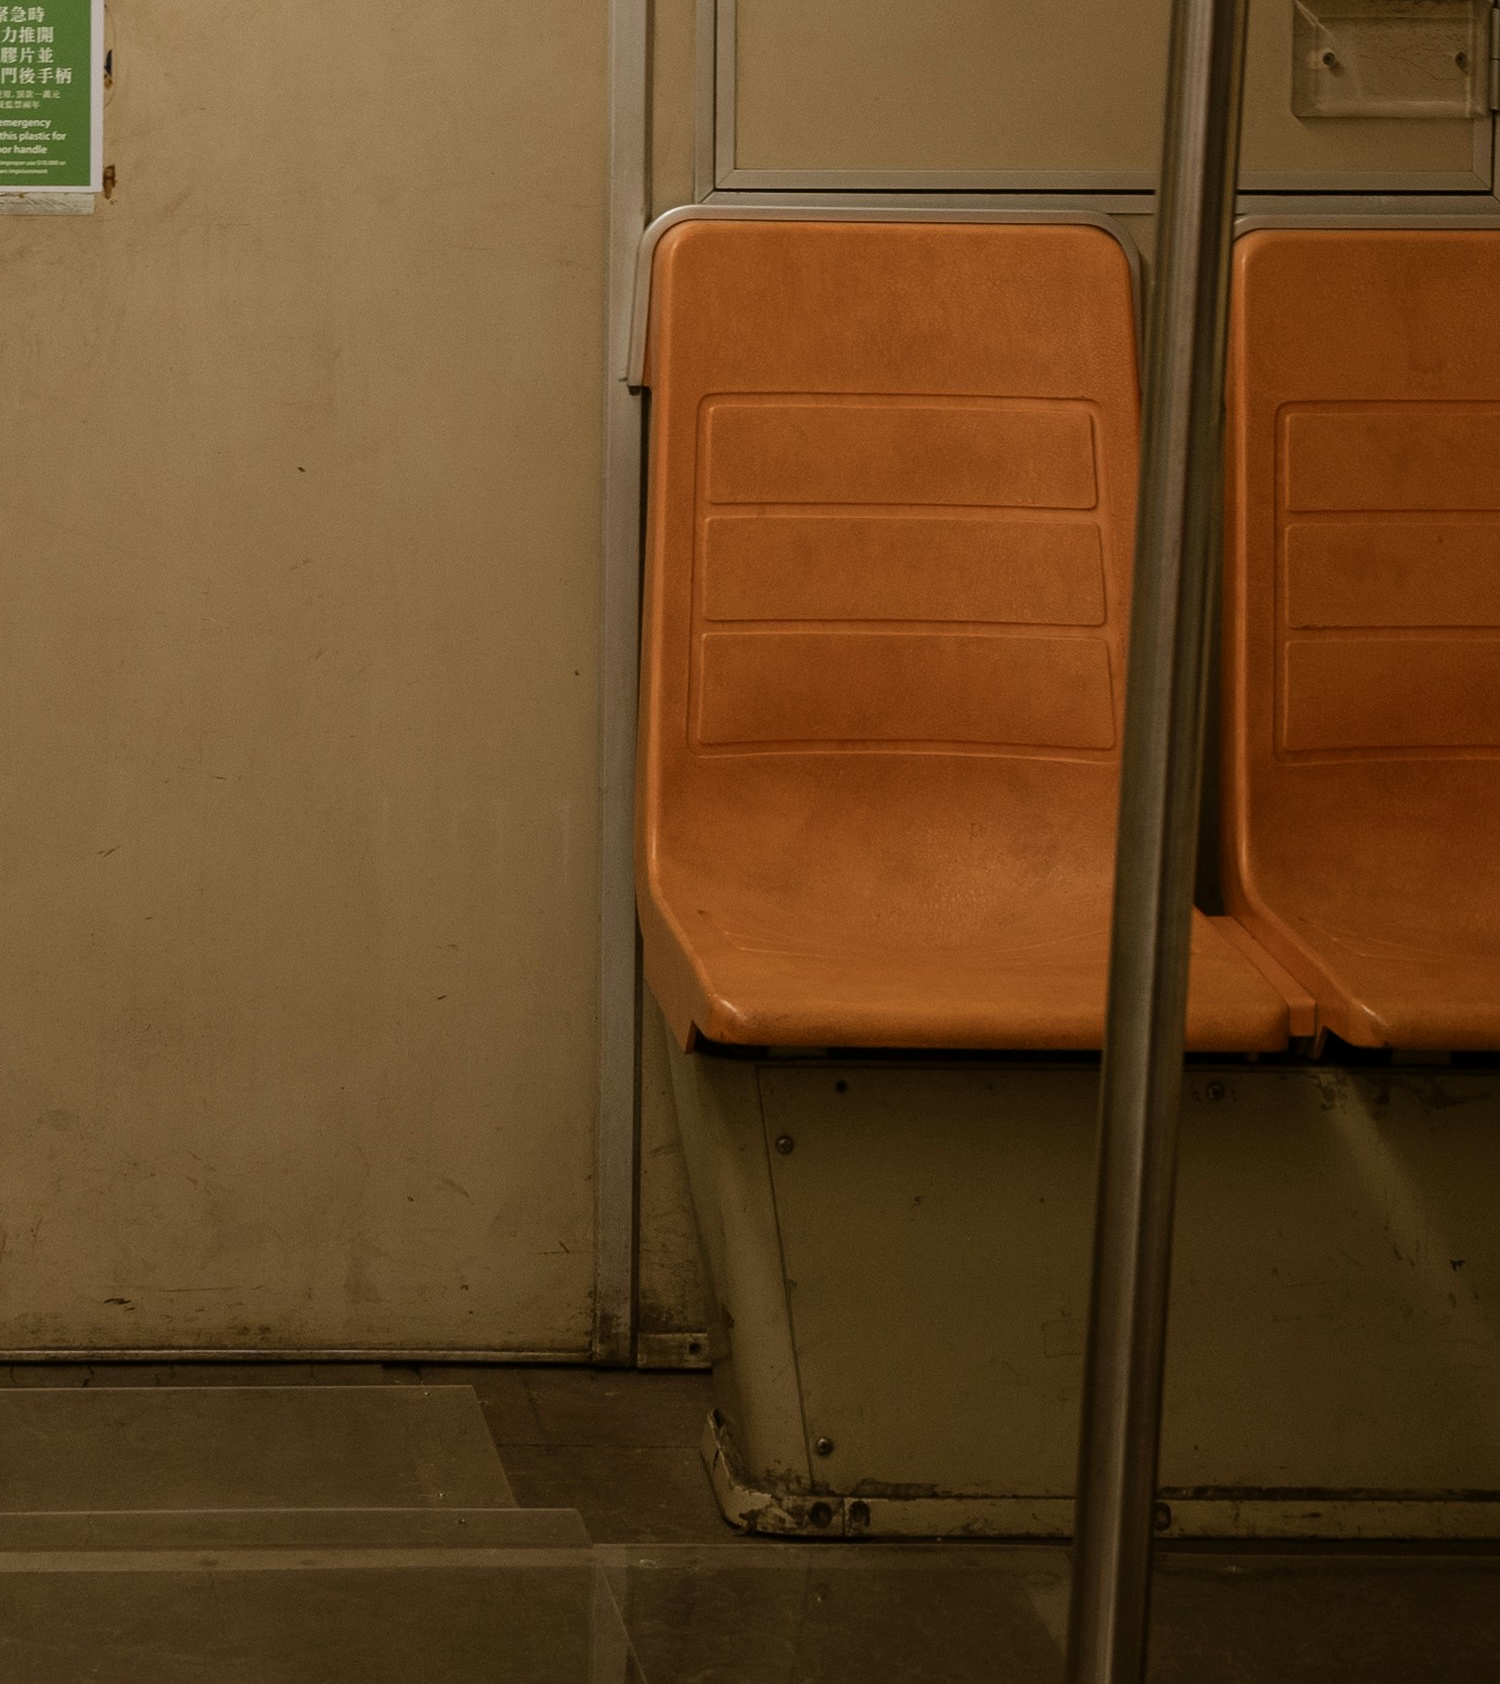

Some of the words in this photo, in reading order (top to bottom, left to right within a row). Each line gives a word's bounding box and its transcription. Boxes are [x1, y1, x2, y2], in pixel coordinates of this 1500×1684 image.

[0, 131, 18, 141] this
[19, 131, 50, 142] plastic
[52, 130, 67, 141] for
[13, 145, 48, 154] handle
